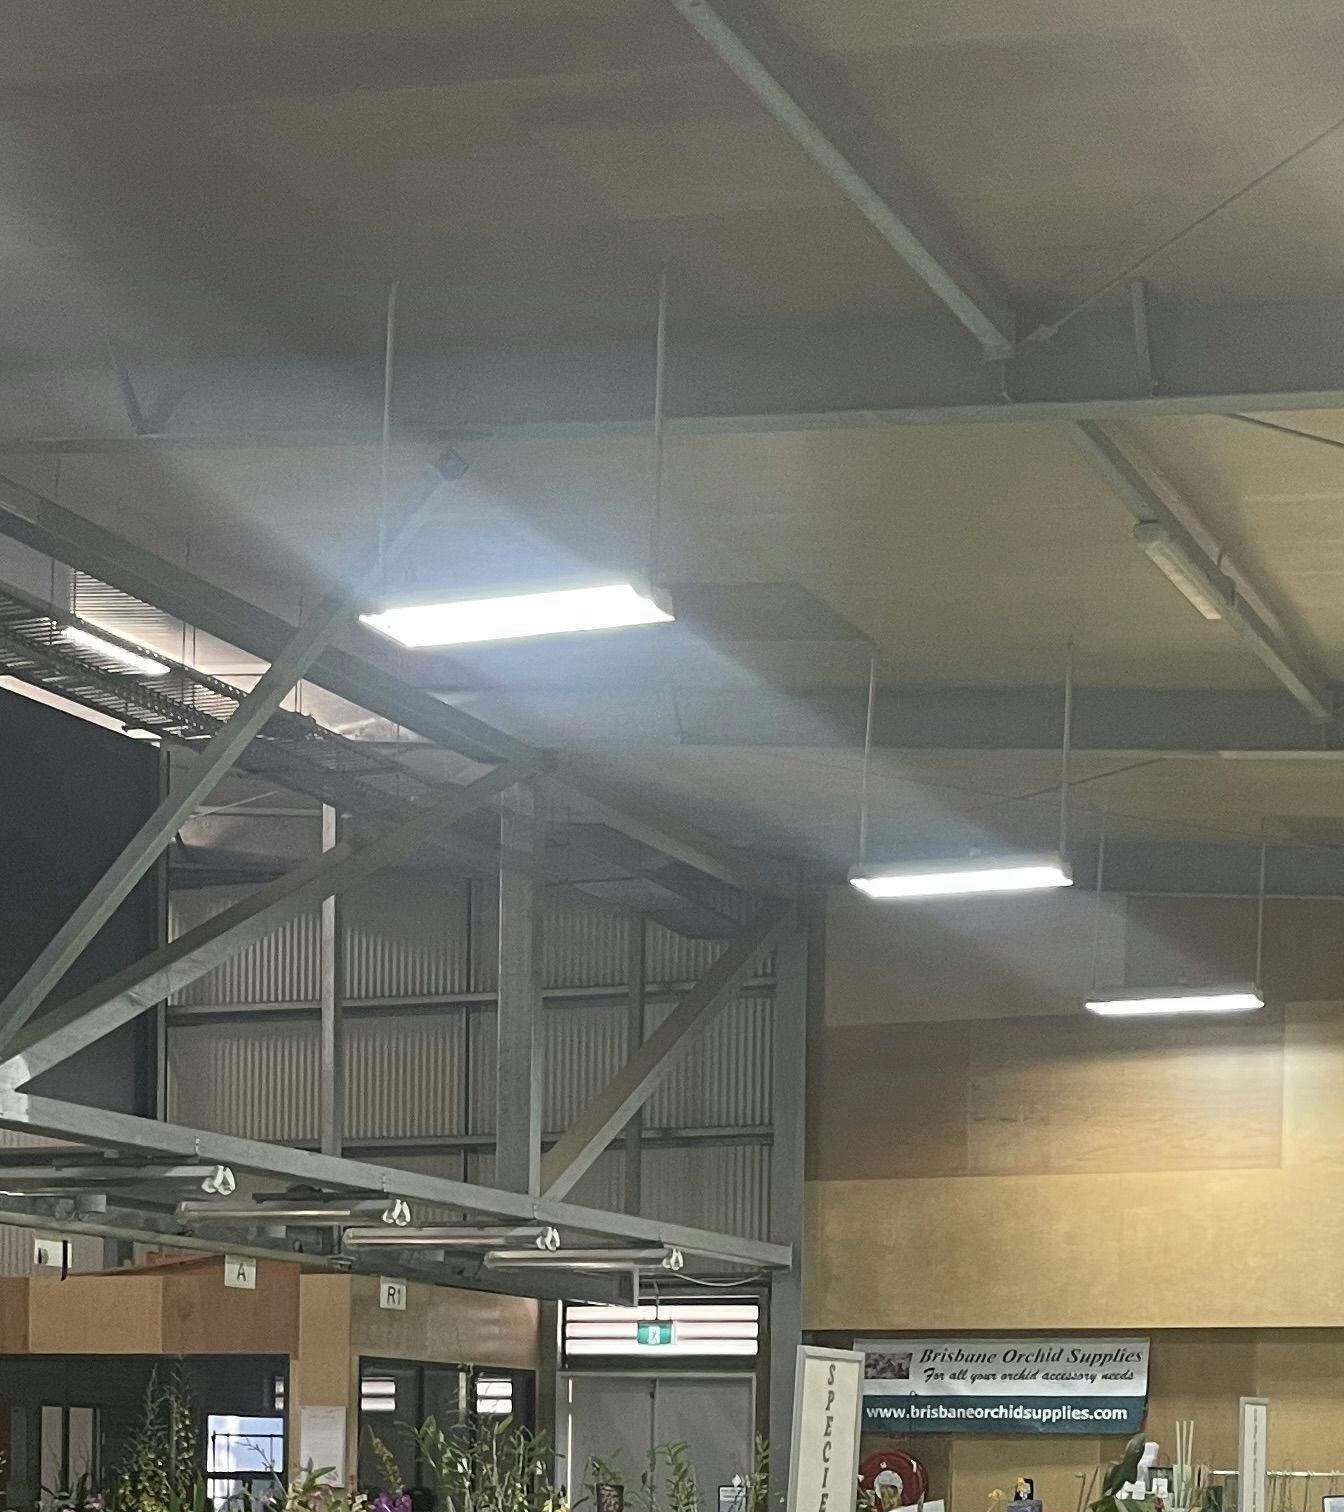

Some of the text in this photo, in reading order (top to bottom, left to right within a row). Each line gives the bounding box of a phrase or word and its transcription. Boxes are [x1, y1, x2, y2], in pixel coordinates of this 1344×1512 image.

[236, 1262, 247, 1282] A
[386, 1285, 401, 1306] R1
[919, 1347, 1144, 1368] Brisbane Orchid Supplies
[923, 1367, 1134, 1385] For all your orchid accessory needs
[866, 1404, 1129, 1423] www.brisbaneorchidsupplies.com
